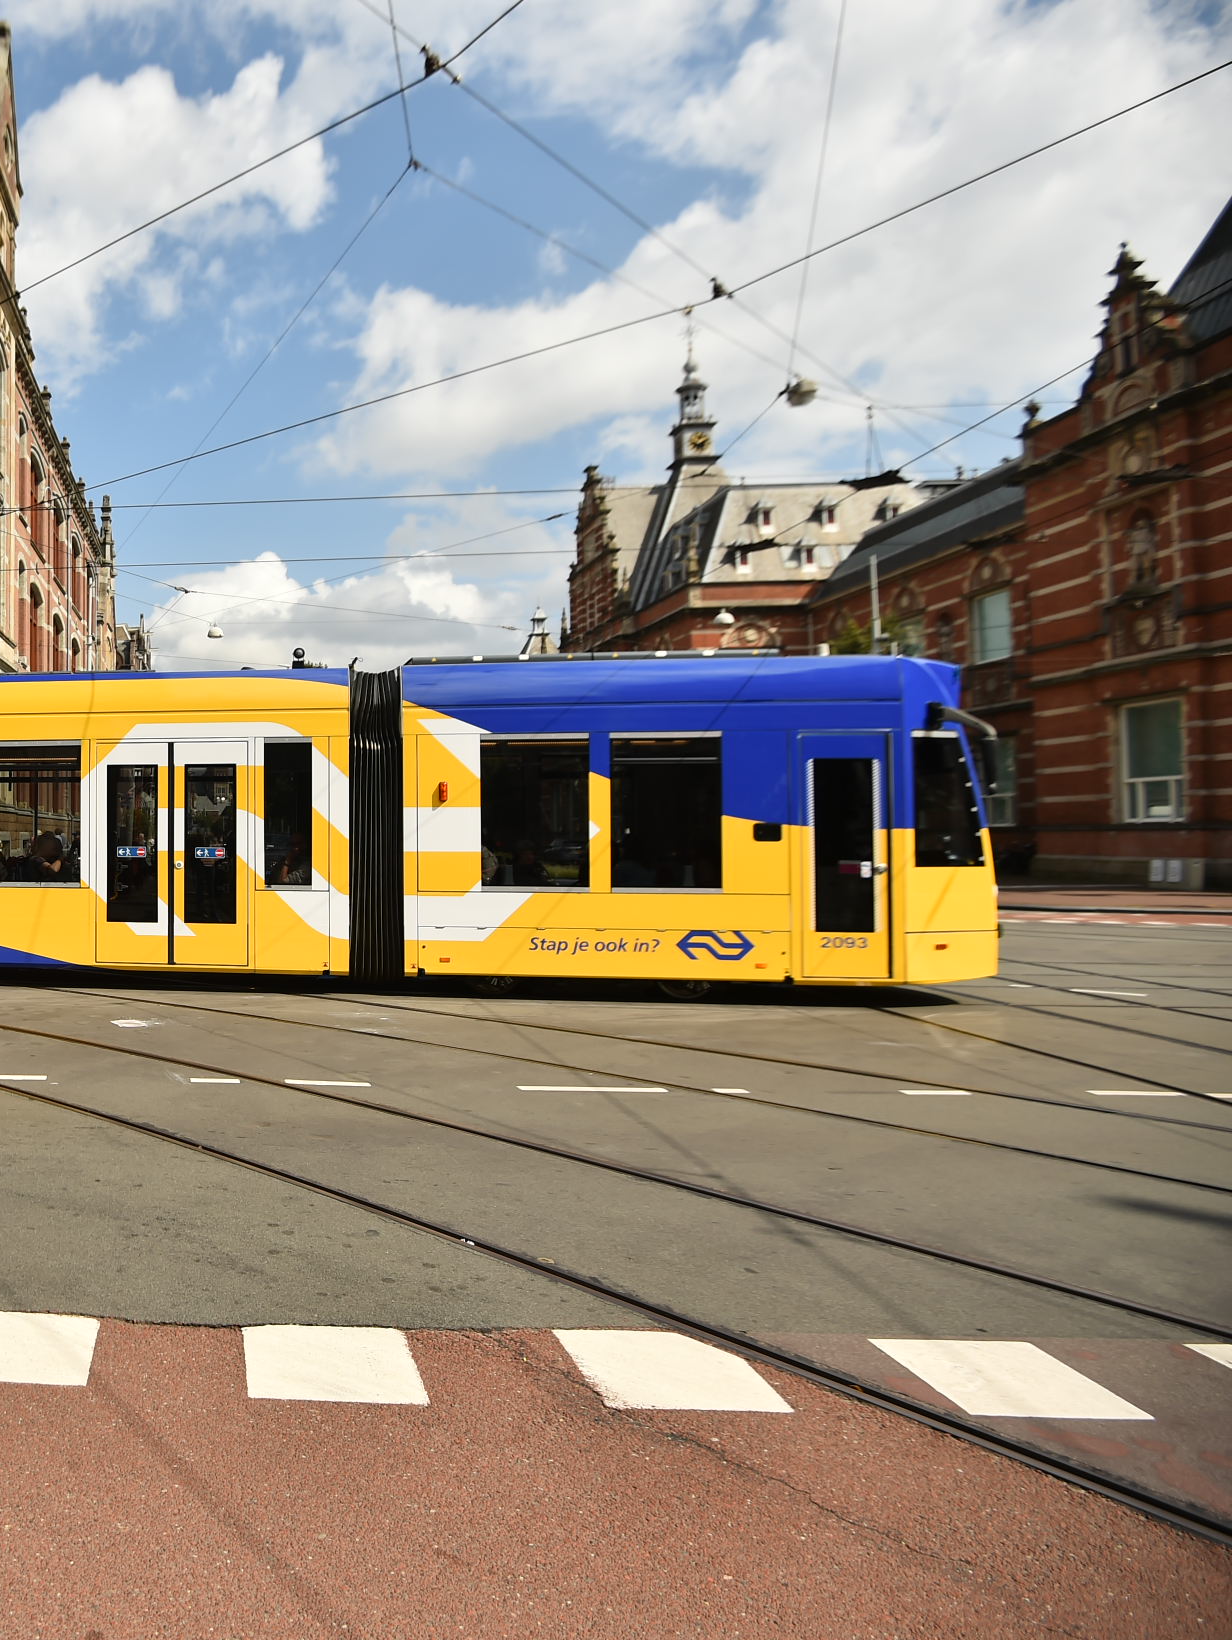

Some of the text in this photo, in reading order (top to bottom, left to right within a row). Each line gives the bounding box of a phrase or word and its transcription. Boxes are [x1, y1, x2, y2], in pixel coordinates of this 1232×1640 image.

[529, 937, 660, 955] Stap je ook in?
[820, 936, 869, 949] 2093
